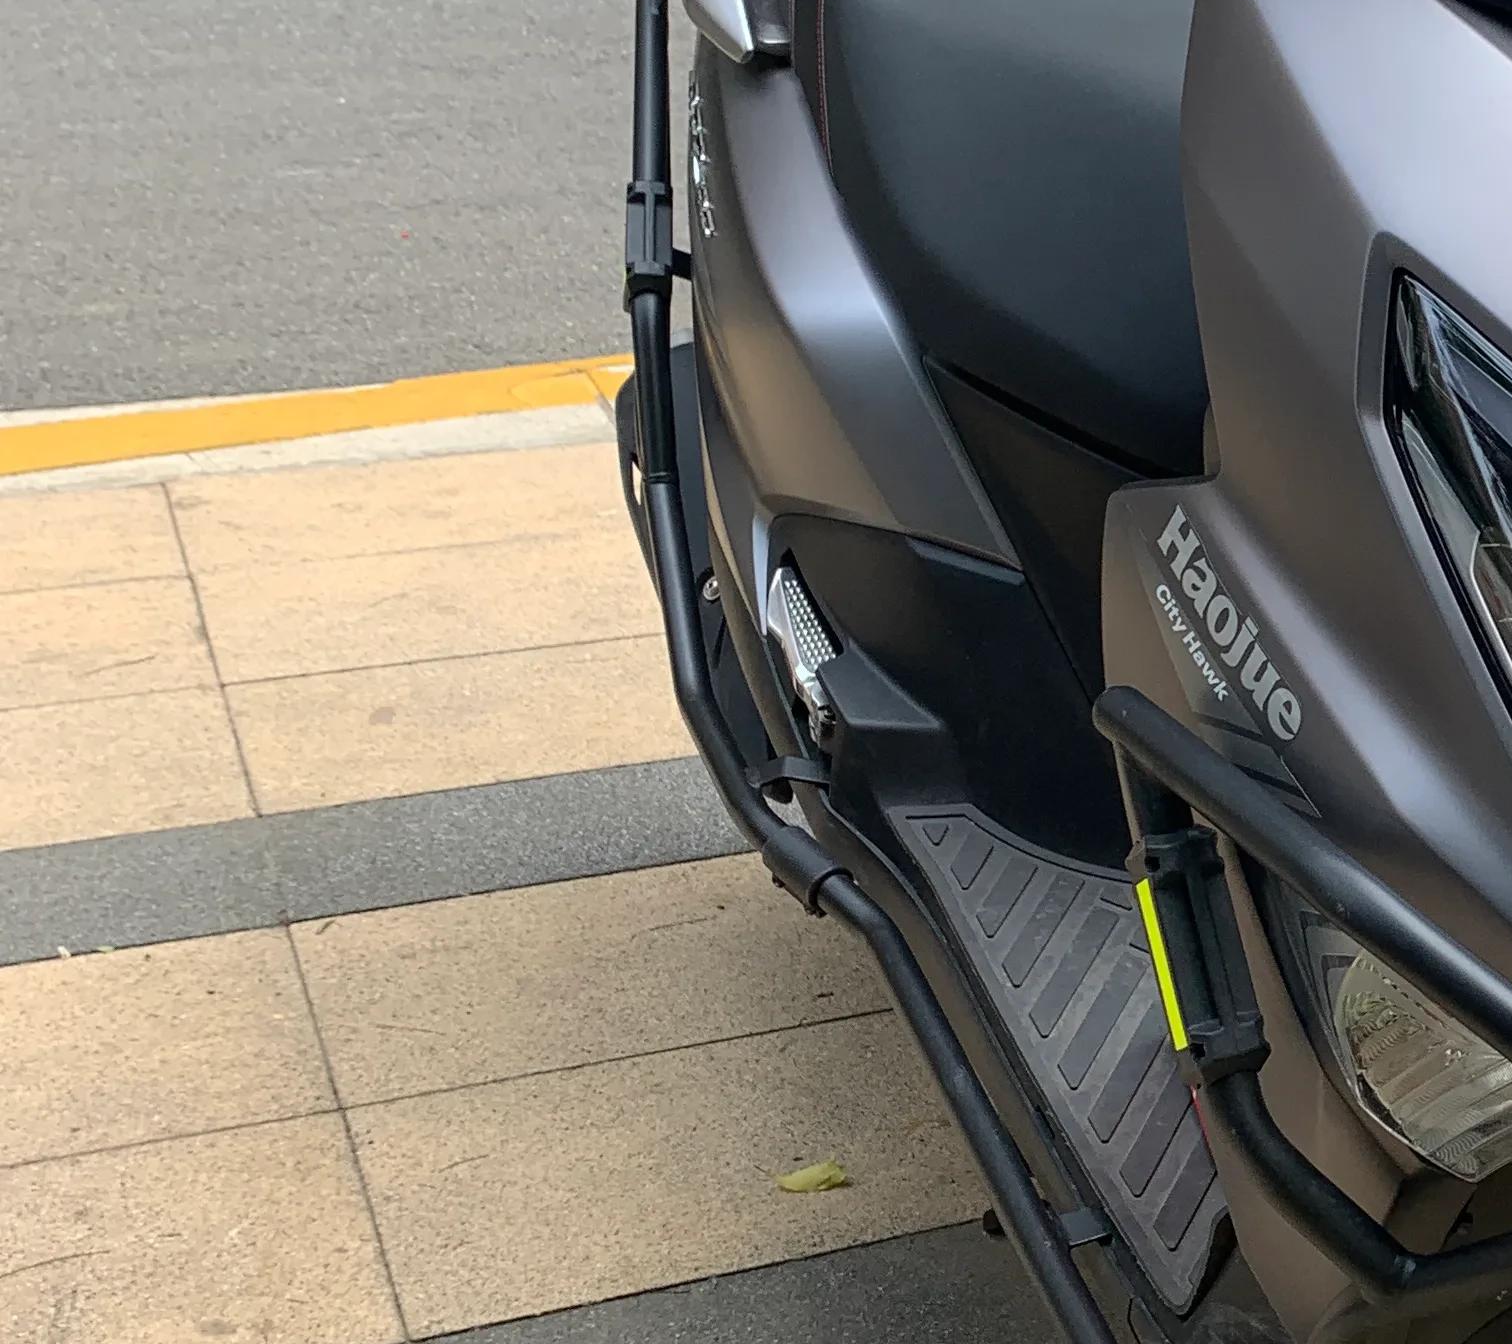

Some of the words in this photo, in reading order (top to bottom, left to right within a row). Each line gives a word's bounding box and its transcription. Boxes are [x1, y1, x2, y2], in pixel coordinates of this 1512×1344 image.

[1155, 583, 1187, 633] City
[1181, 630, 1230, 702] Hawk
[1157, 504, 1301, 741] Haojue
